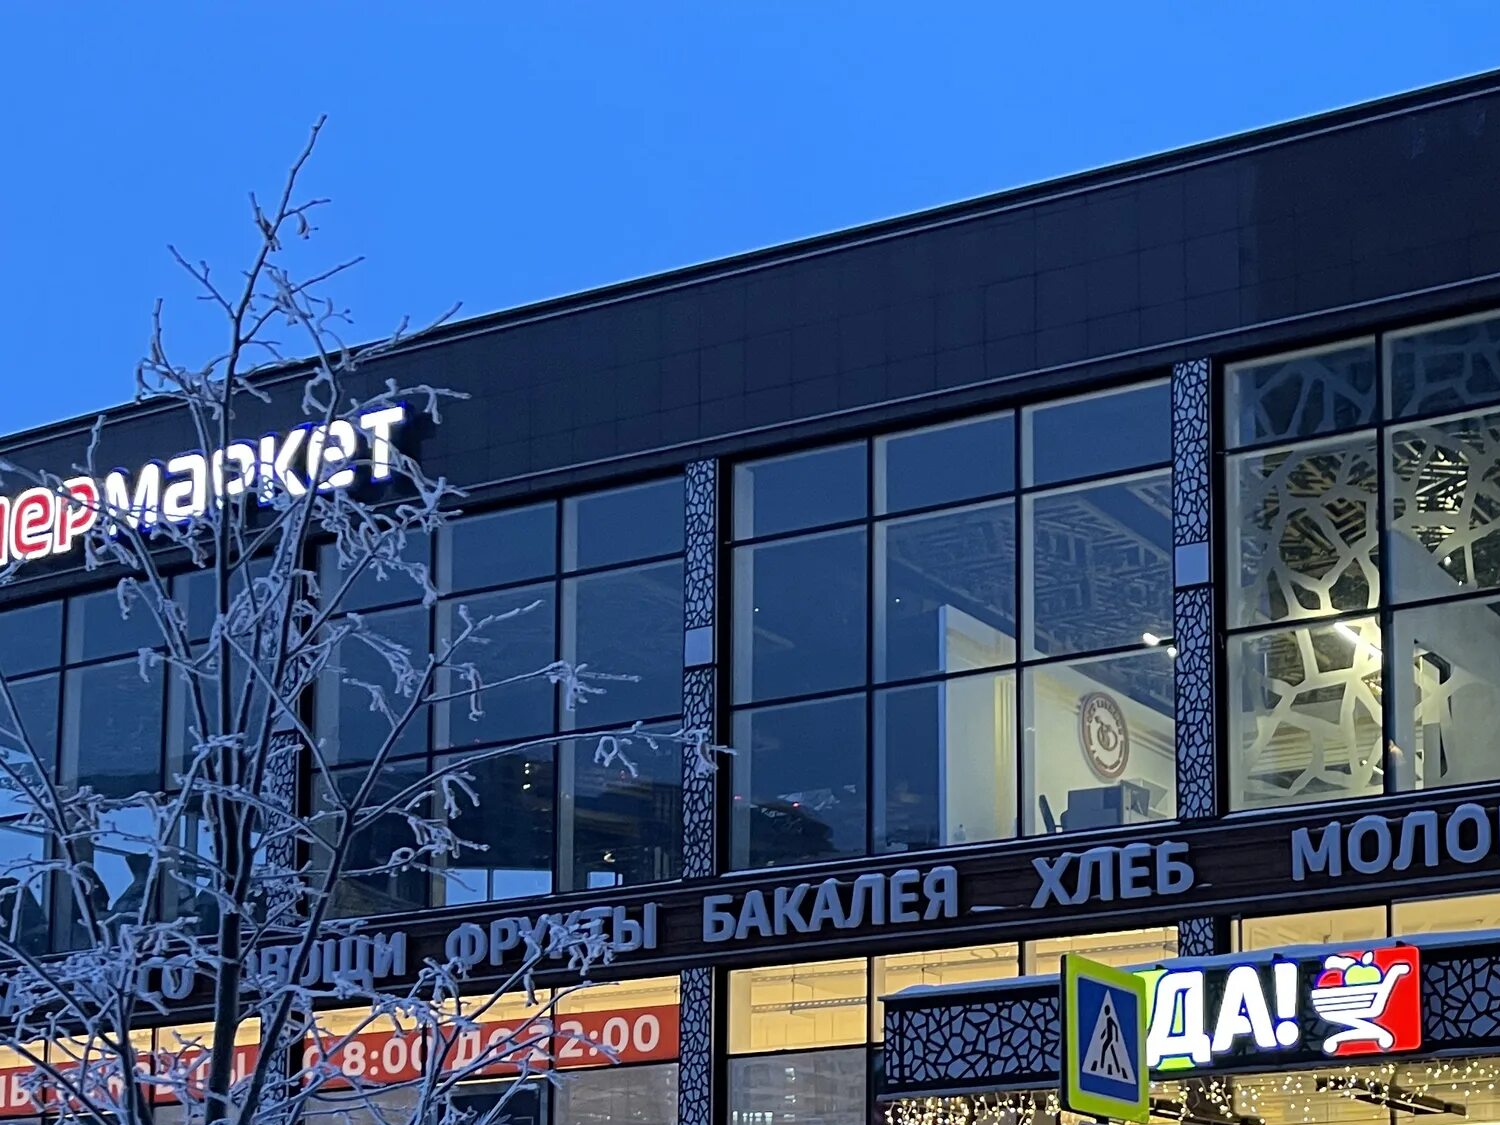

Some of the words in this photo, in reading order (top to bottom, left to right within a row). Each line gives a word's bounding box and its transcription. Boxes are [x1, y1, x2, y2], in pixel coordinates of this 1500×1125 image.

[0, 406, 405, 565] ермаркет
[703, 866, 959, 942] БАКАЛЕЯ
[1031, 842, 1194, 909] ХЛЕБ
[528, 1014, 660, 1064] 22:00
[1146, 961, 1299, 1067] ДА!
